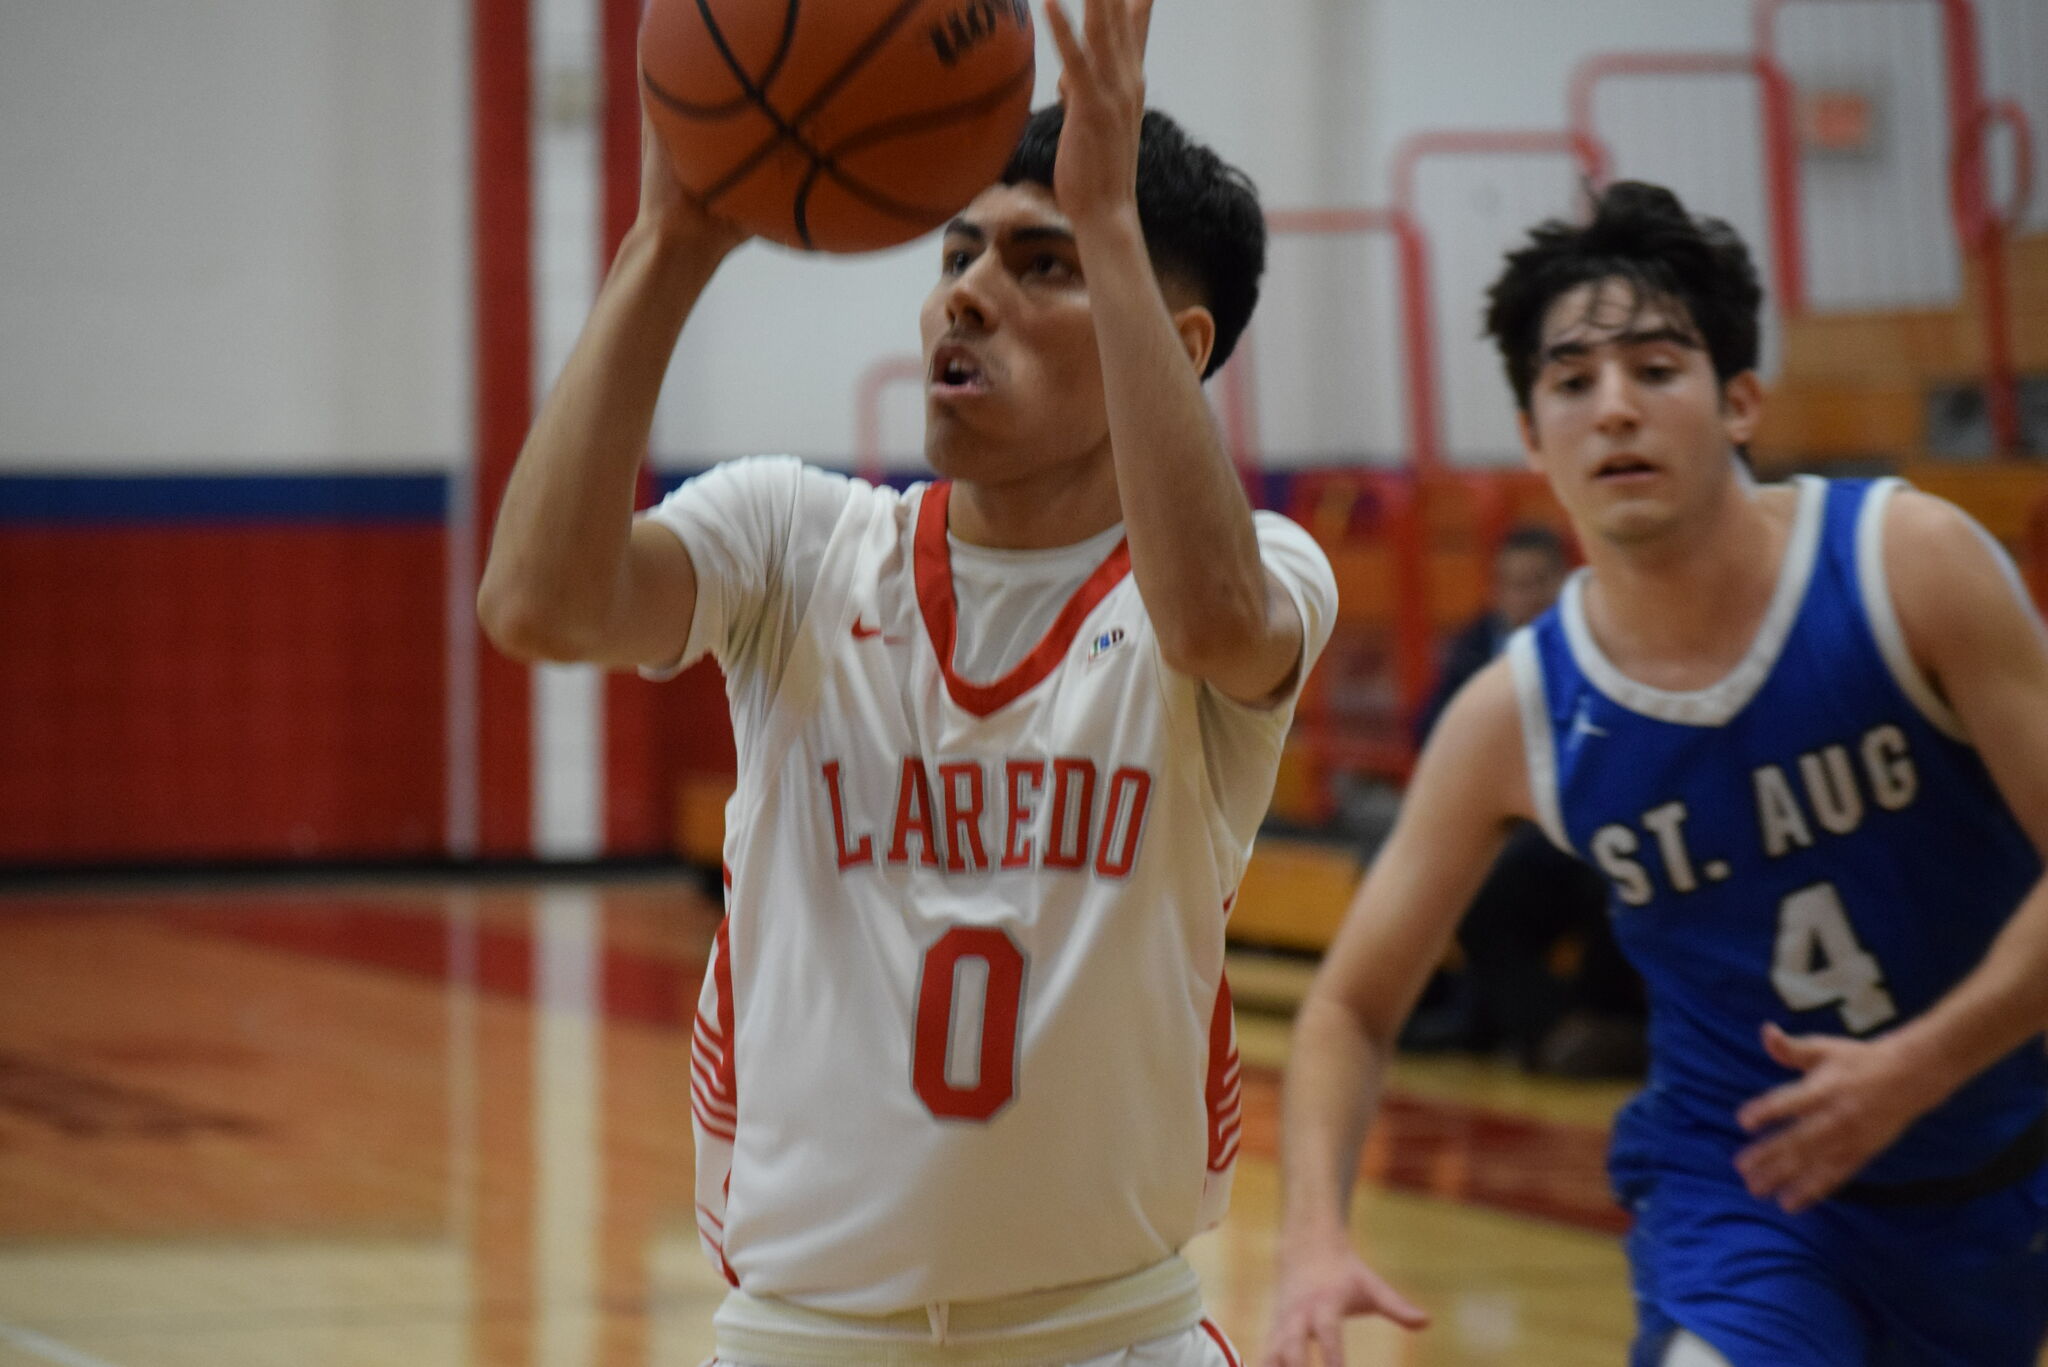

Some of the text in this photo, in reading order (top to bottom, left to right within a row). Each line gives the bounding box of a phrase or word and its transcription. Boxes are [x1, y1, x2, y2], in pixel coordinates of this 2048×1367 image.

[820, 756, 1153, 879] LAREDO
[1590, 723, 1920, 907] ST. AUG
[911, 924, 1029, 1123] 0
[1768, 881, 1898, 1034] 4
